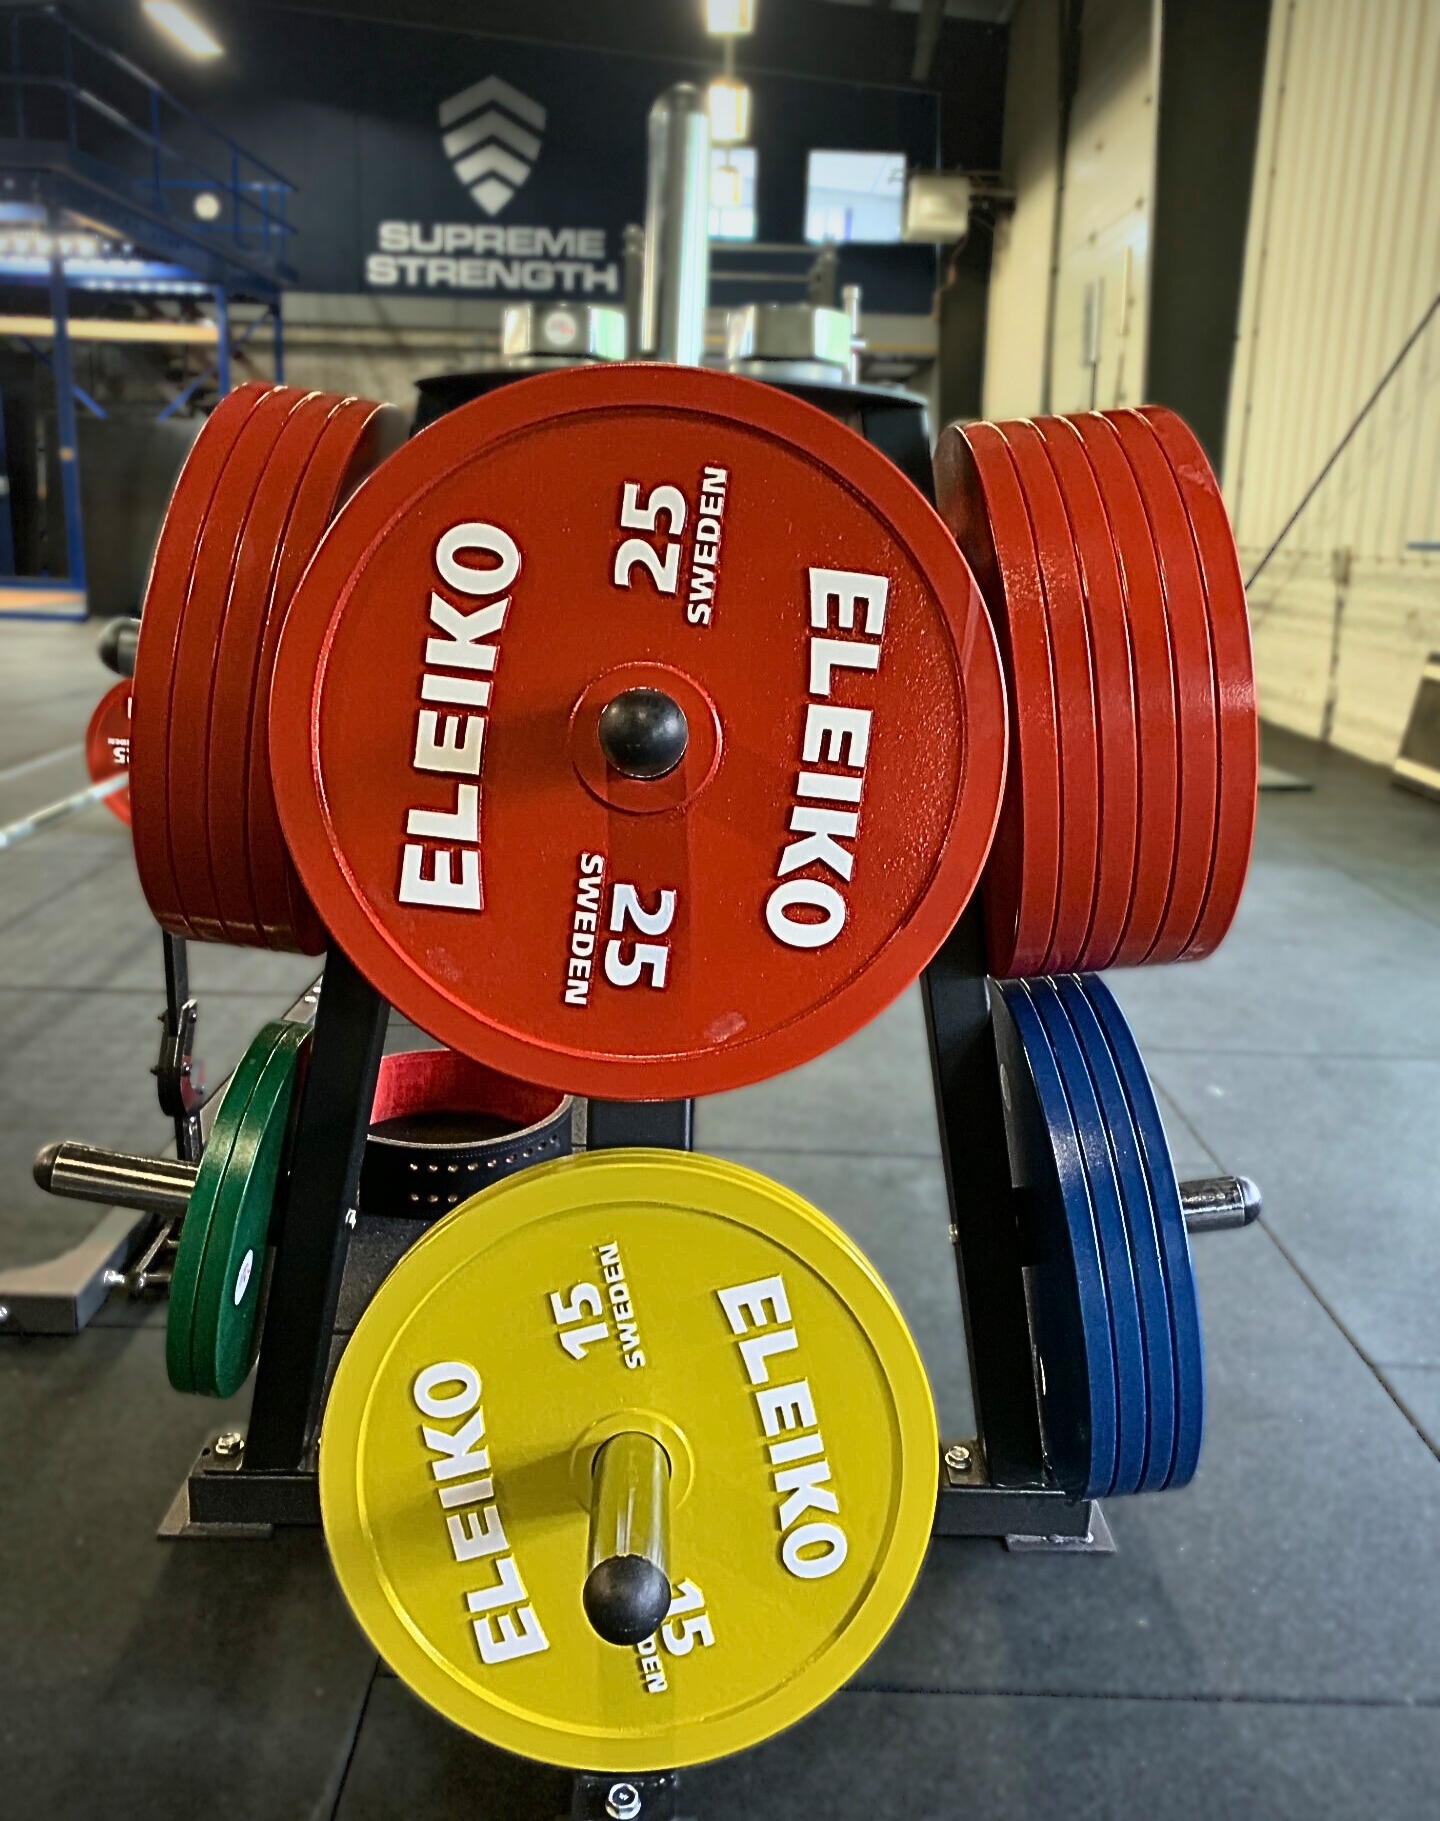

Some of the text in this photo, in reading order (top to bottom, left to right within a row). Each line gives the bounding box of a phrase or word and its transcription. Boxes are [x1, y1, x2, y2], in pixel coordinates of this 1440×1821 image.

[366, 255, 618, 292] STRENGTH
[377, 221, 606, 259] SUPREME
[614, 482, 688, 594] 25
[687, 466, 728, 626] SWEDEN
[112, 746, 130, 764] 5
[398, 521, 521, 911] ELEIKO
[765, 566, 889, 949] ELEIKO
[565, 853, 605, 1005] SWEDEN
[604, 882, 677, 988] 25
[551, 1281, 610, 1360] 15
[599, 1242, 646, 1369] SWEDEN
[717, 1275, 849, 1580] ELEIKO
[413, 1360, 549, 1664] ELEIKO
[660, 1578, 716, 1657] 15
